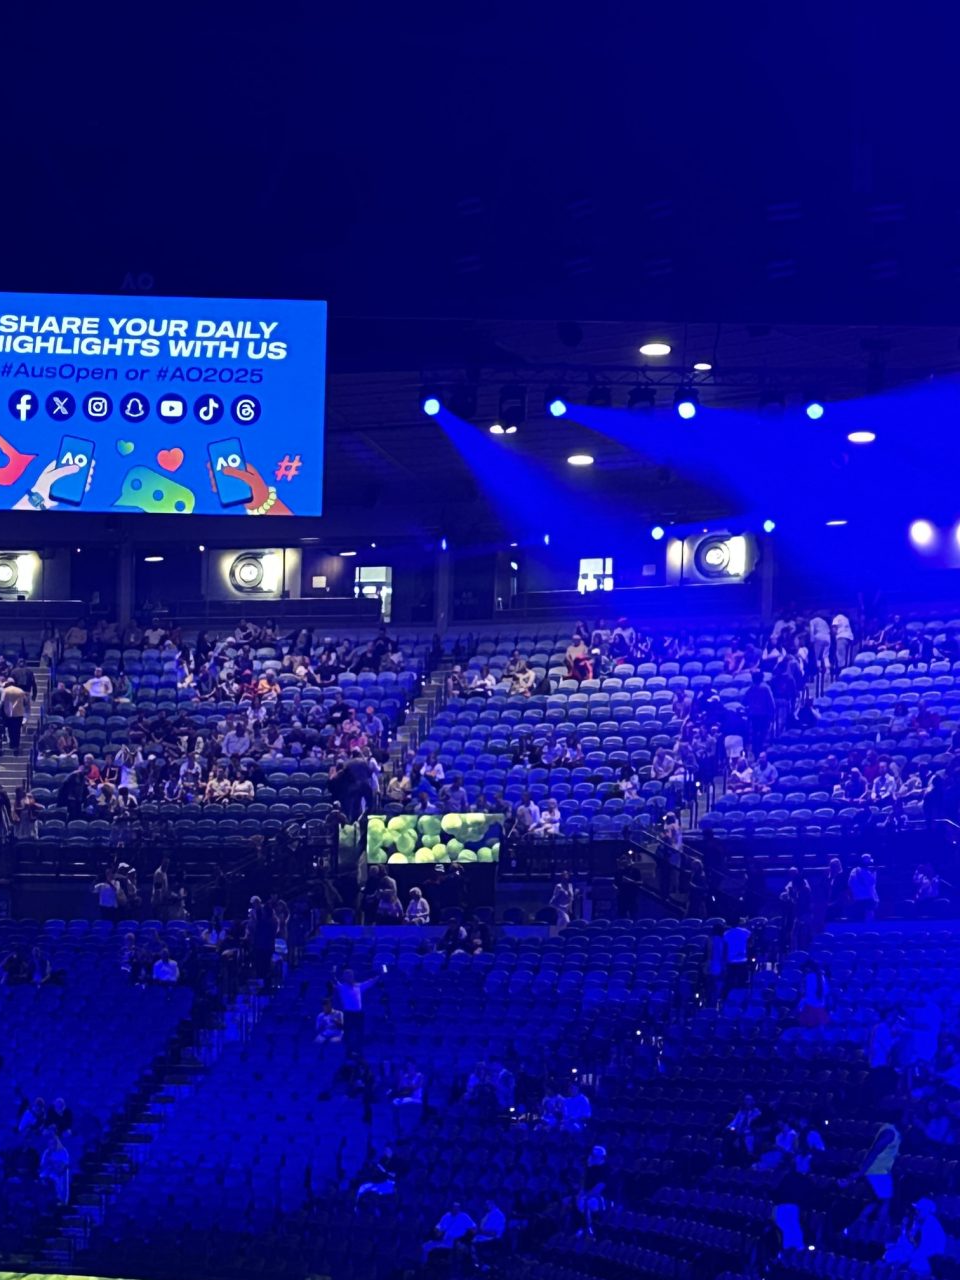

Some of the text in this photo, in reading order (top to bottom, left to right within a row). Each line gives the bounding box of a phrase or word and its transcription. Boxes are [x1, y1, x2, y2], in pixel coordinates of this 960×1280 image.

[108, 317, 189, 337] YOUR
[195, 320, 279, 339] DAILY
[168, 339, 240, 359] WITH
[247, 341, 288, 360] US
[0, 362, 264, 384] #AusOpen or #AO2025
[61, 451, 88, 468] AO
[216, 453, 241, 471] AO
